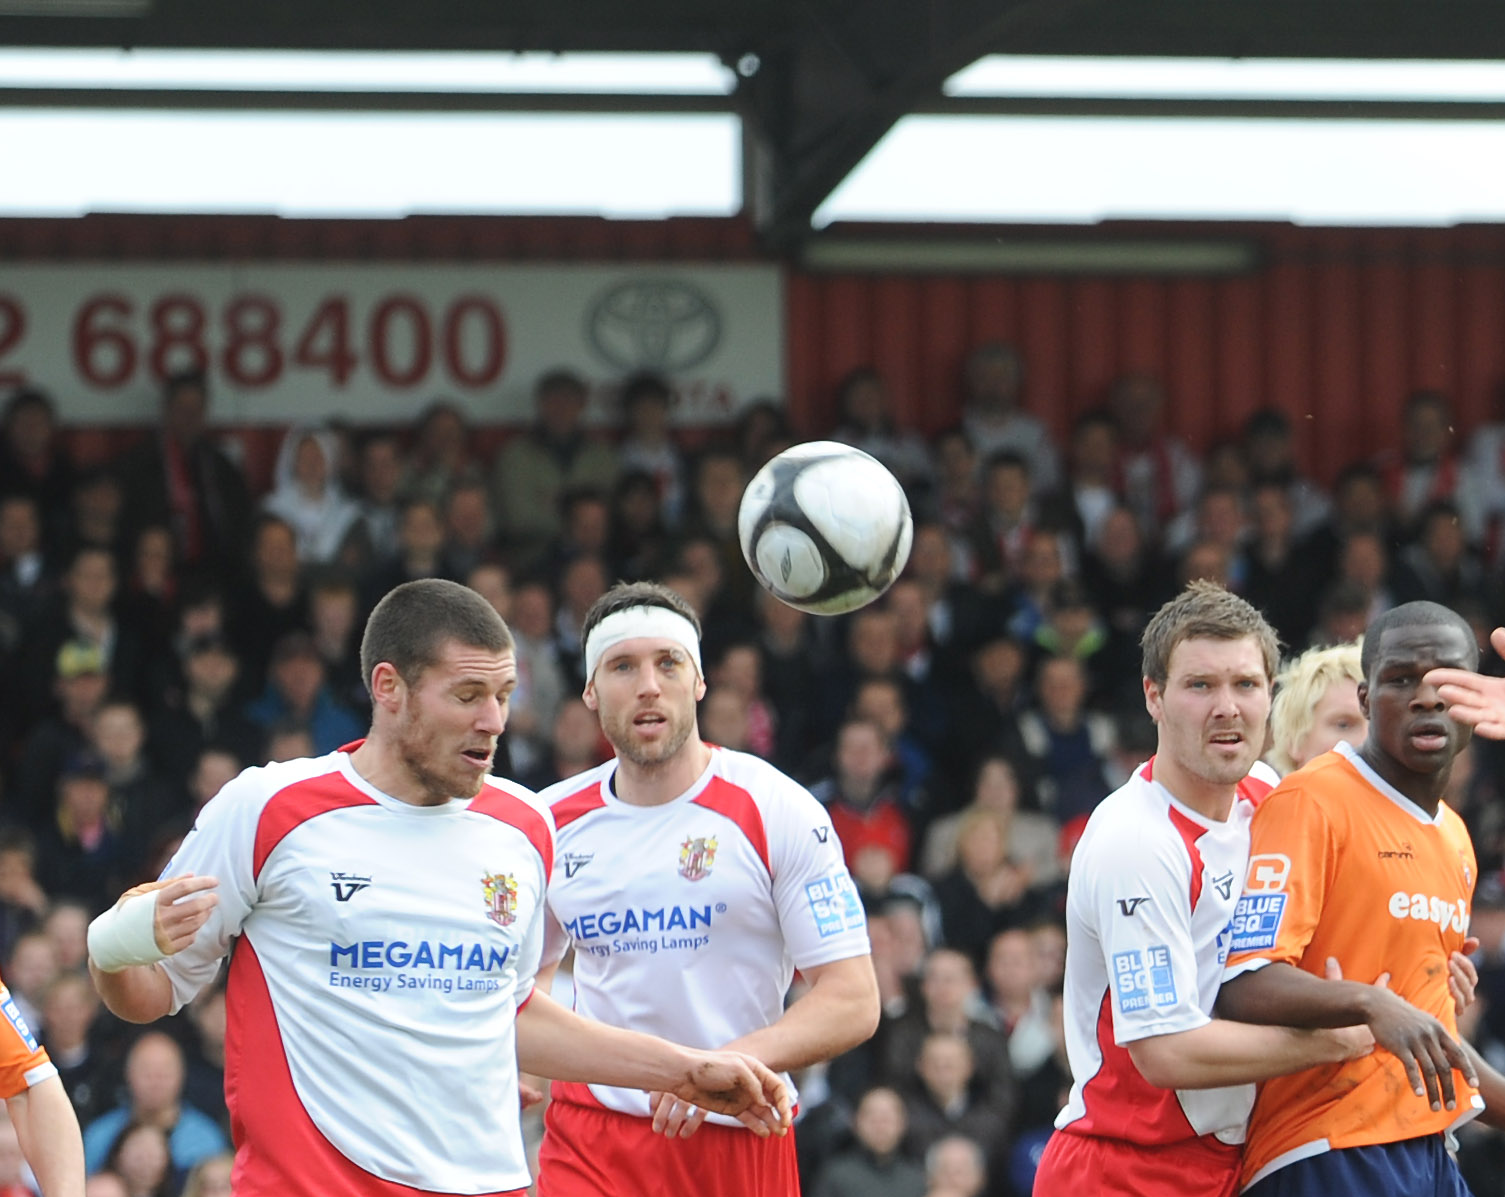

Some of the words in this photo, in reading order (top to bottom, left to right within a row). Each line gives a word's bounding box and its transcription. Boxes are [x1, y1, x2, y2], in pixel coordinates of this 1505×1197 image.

[70, 291, 509, 390] 688400
[1236, 897, 1282, 916] BLUE
[563, 904, 712, 942] MEGAMAN
[1232, 915, 1261, 935] SQ
[329, 940, 511, 972] MEGAMAN
[613, 938, 658, 954] Saving
[661, 934, 709, 950] Lamps
[1115, 949, 1169, 974] BLUE
[329, 971, 393, 993] Energy
[397, 973, 453, 994] Saving
[457, 975, 500, 994] Lamps
